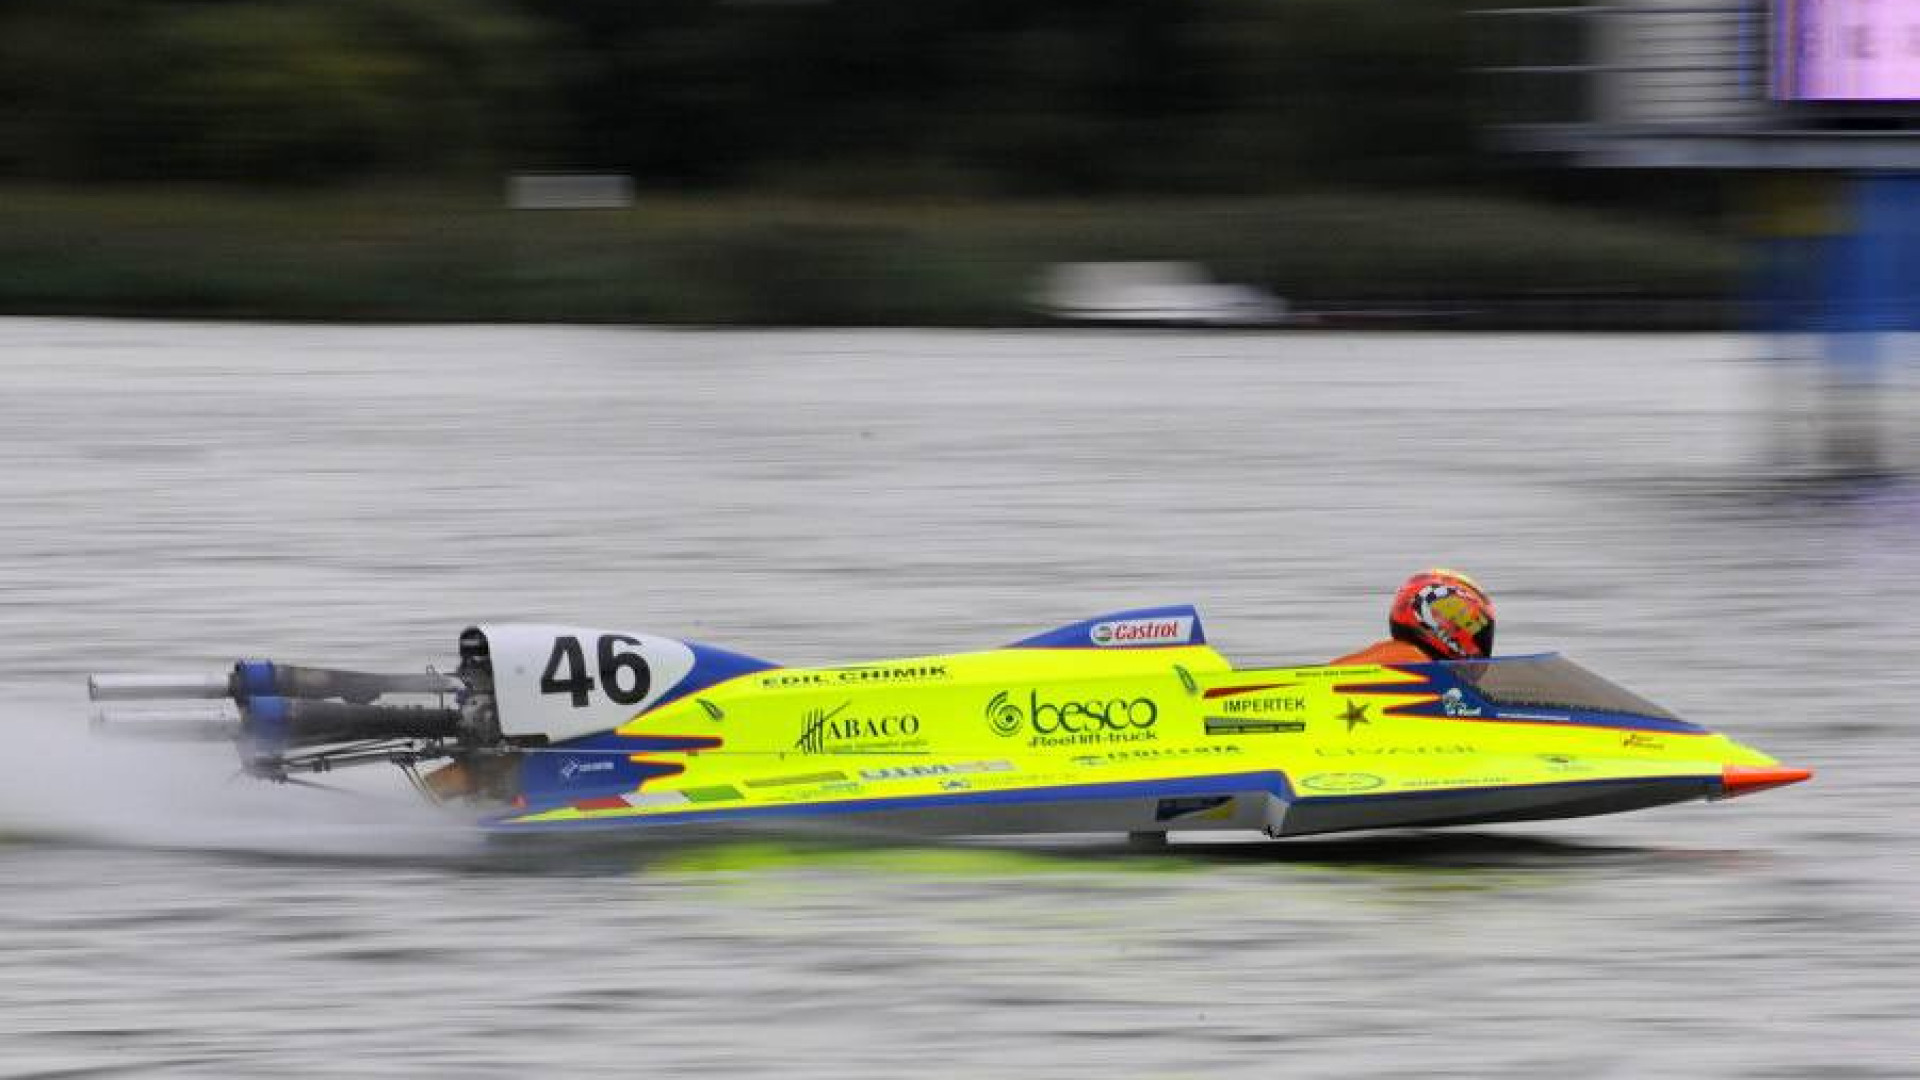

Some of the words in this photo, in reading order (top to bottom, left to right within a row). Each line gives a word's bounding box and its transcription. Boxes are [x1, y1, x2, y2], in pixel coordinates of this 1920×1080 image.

[1115, 621, 1179, 640] Castrol
[541, 634, 651, 708] 46
[1030, 688, 1158, 734] besco
[1223, 698, 1306, 714] IMPERTEK
[828, 713, 920, 741] ABACO
